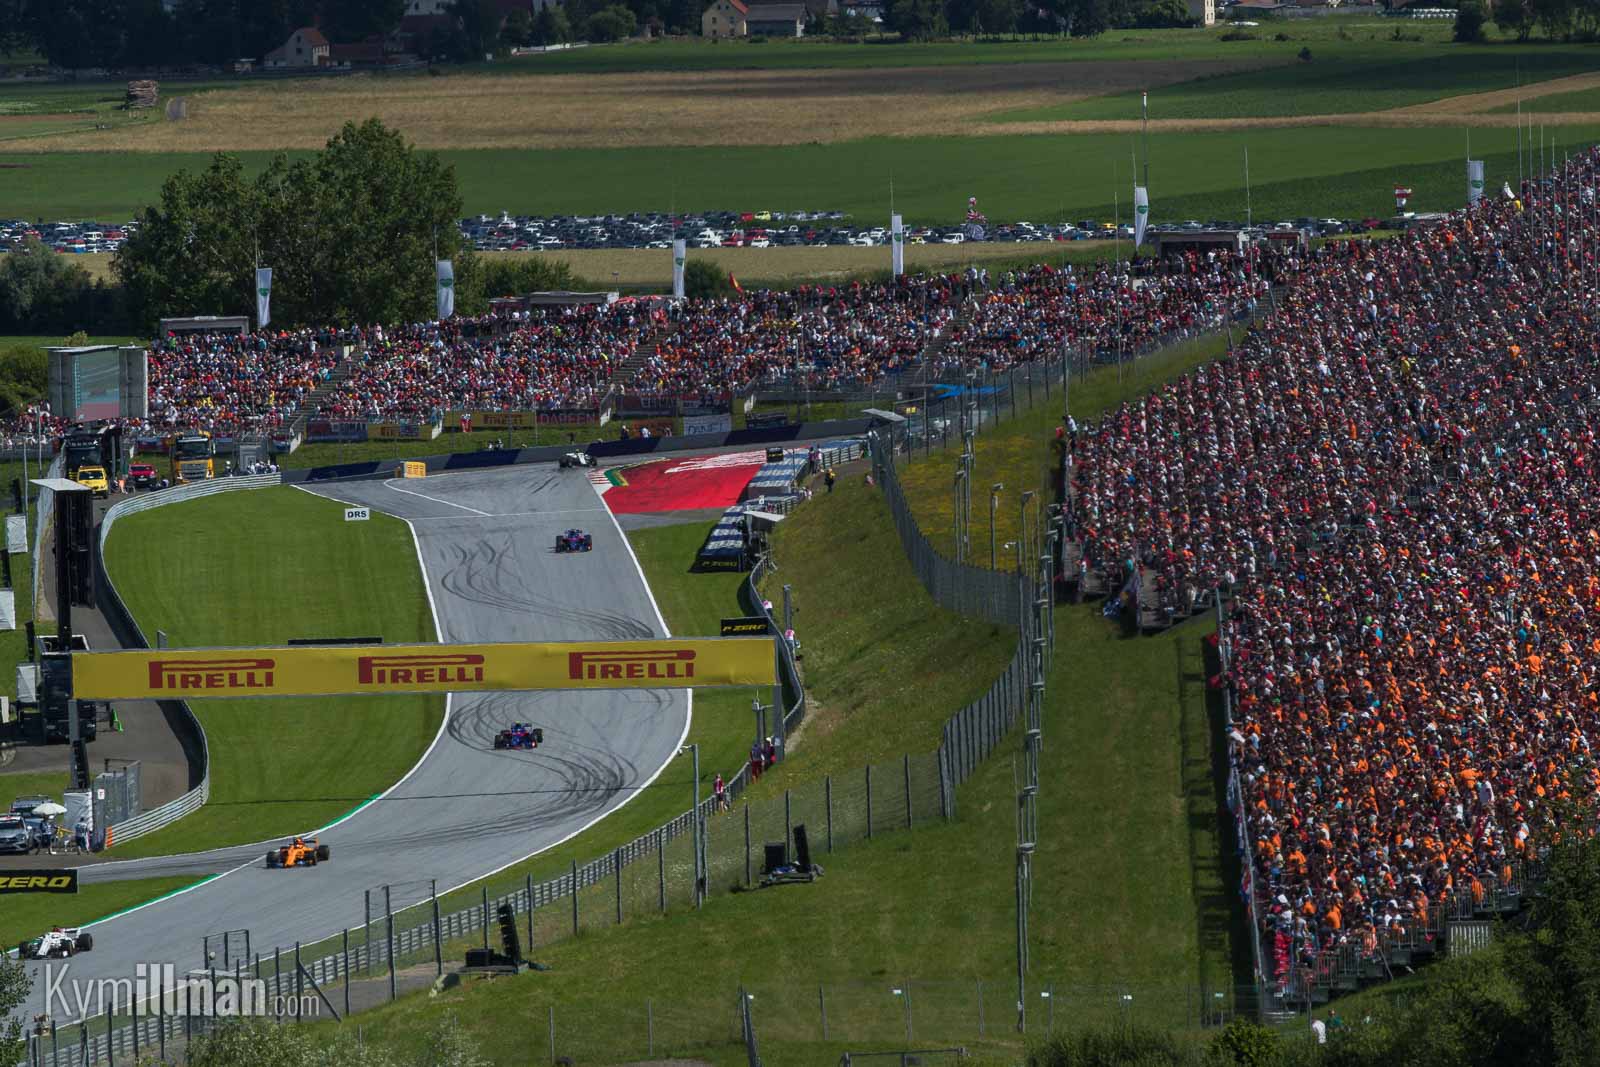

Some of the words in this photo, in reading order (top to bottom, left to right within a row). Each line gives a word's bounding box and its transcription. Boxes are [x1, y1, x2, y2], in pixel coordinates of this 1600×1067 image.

[347, 510, 367, 518] DRS
[149, 658, 275, 689] PIRELLI
[357, 653, 485, 684] PIRELLI
[568, 650, 696, 680] PIRELLI
